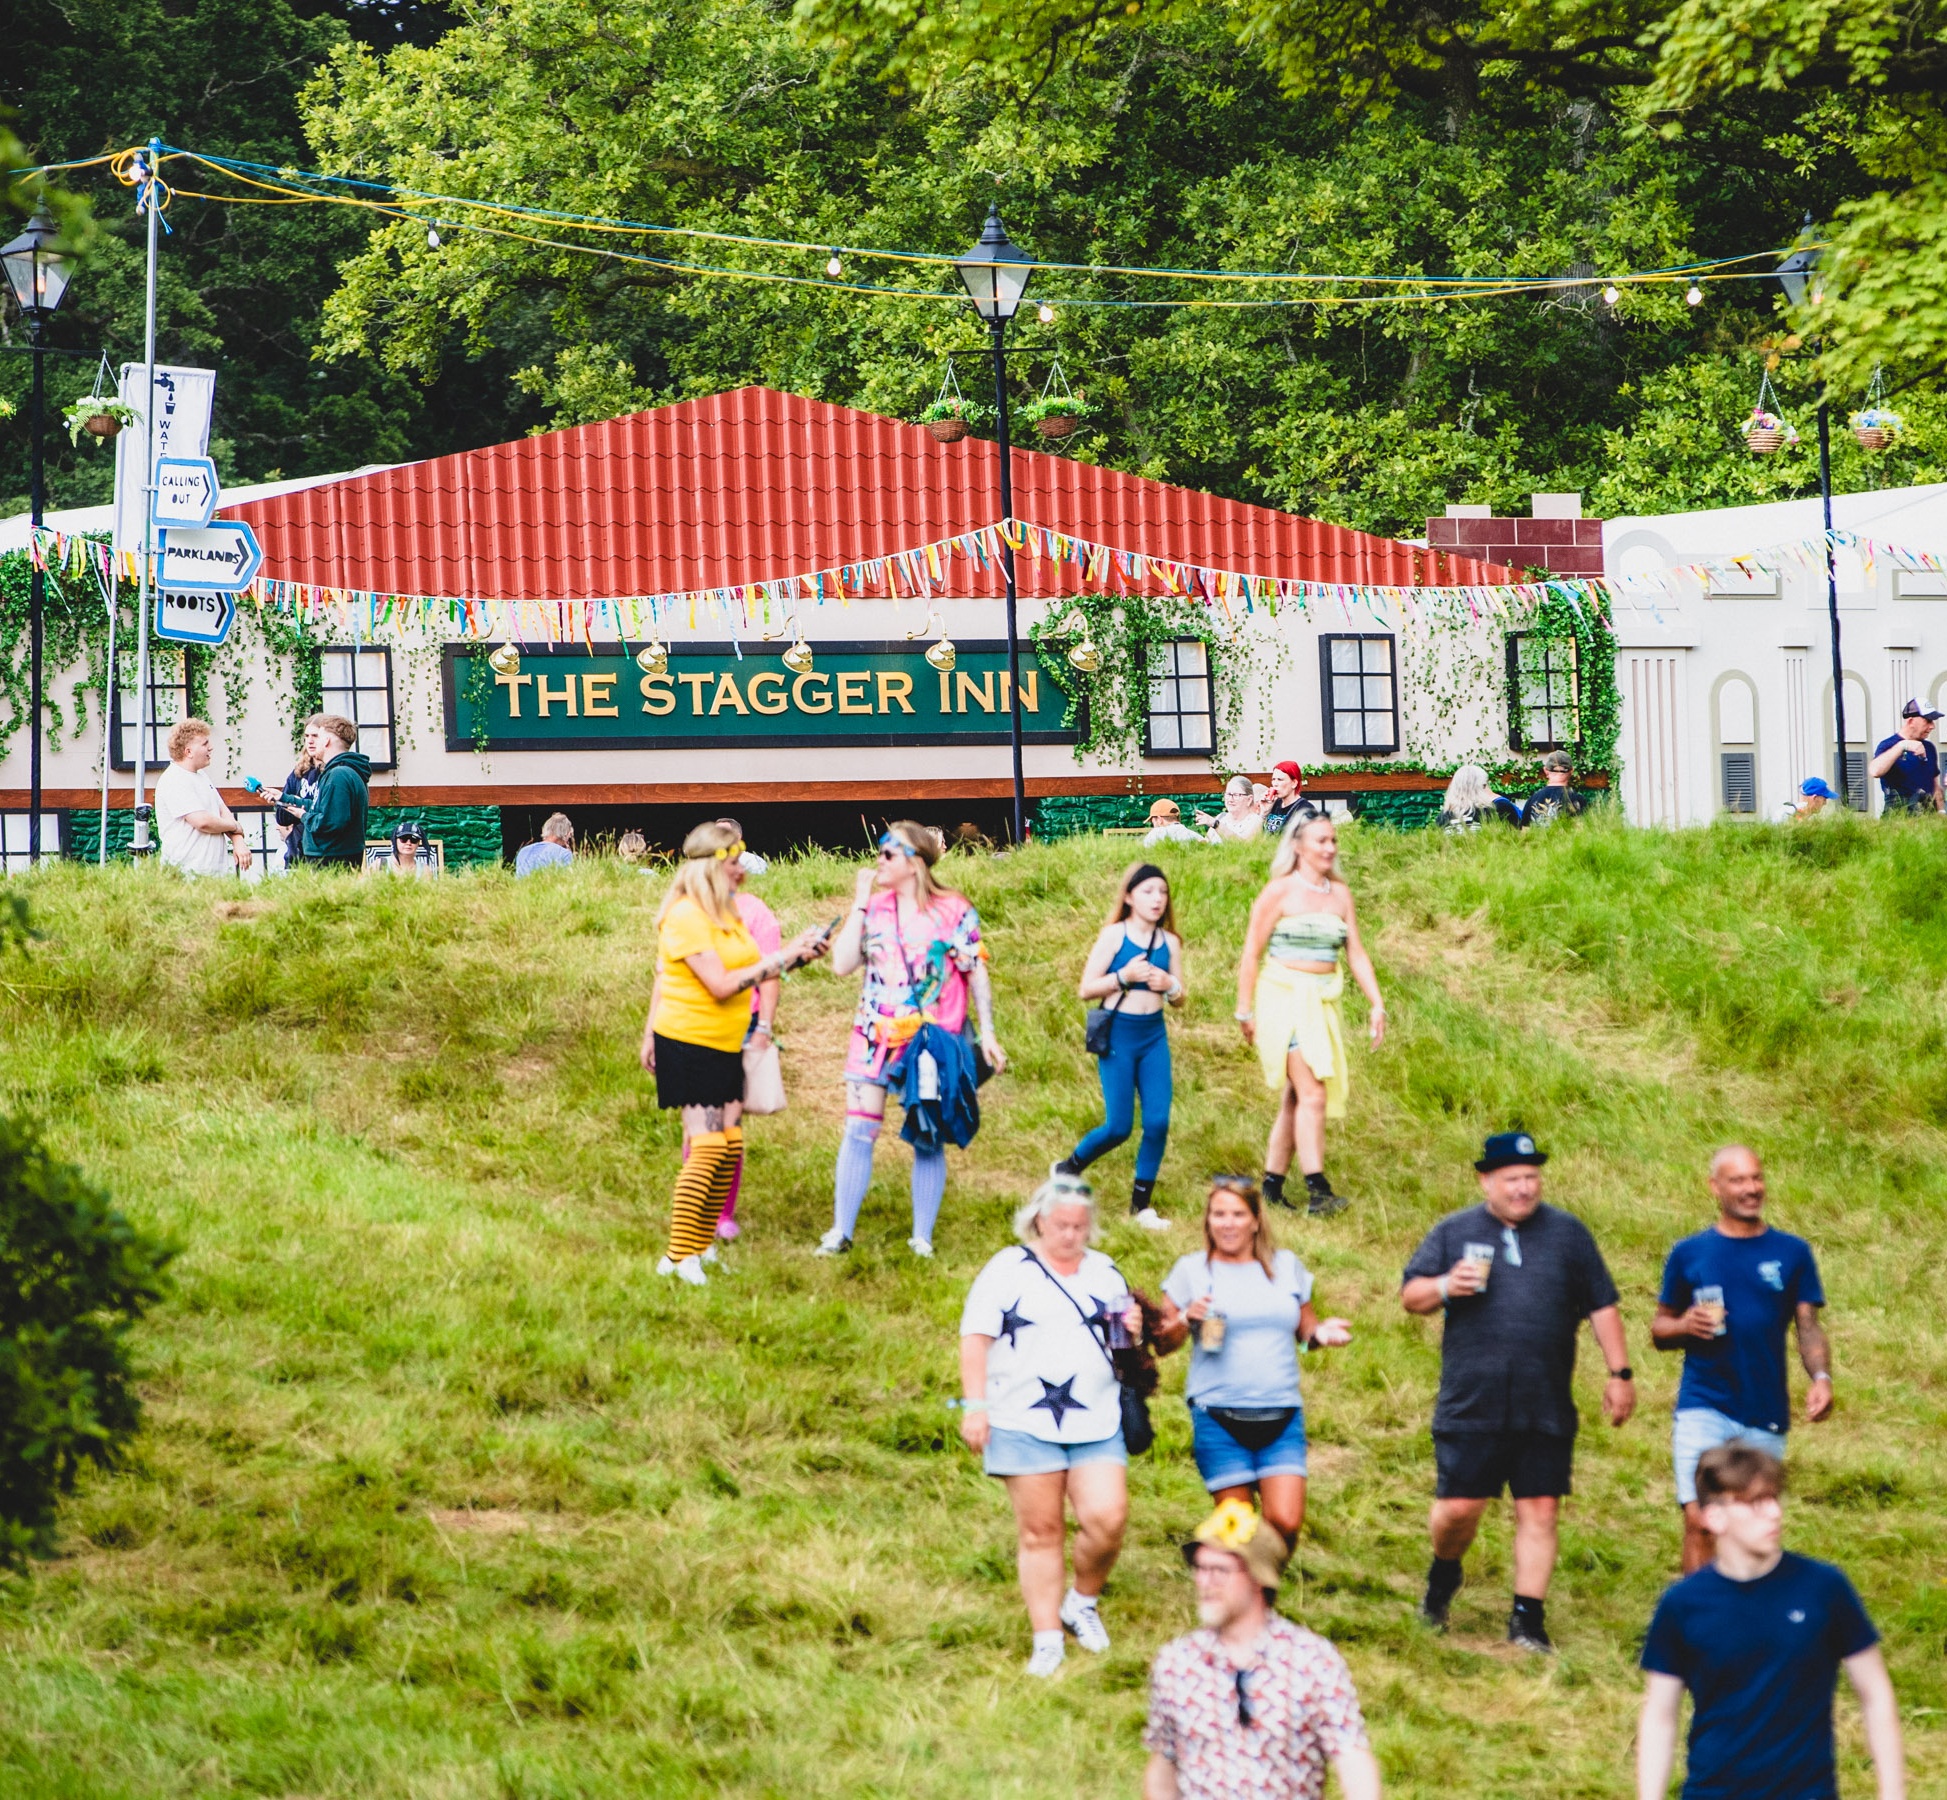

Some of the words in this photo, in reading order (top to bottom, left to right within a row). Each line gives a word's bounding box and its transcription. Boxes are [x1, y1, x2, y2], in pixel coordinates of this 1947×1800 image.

[162, 476, 200, 487] CALLING
[172, 493, 190, 504] OUT
[167, 547, 241, 564] PARKLANDS
[165, 593, 215, 612] ROOTS
[494, 673, 619, 718] THE
[639, 670, 916, 717] STAGGER
[938, 670, 1040, 714] INN
